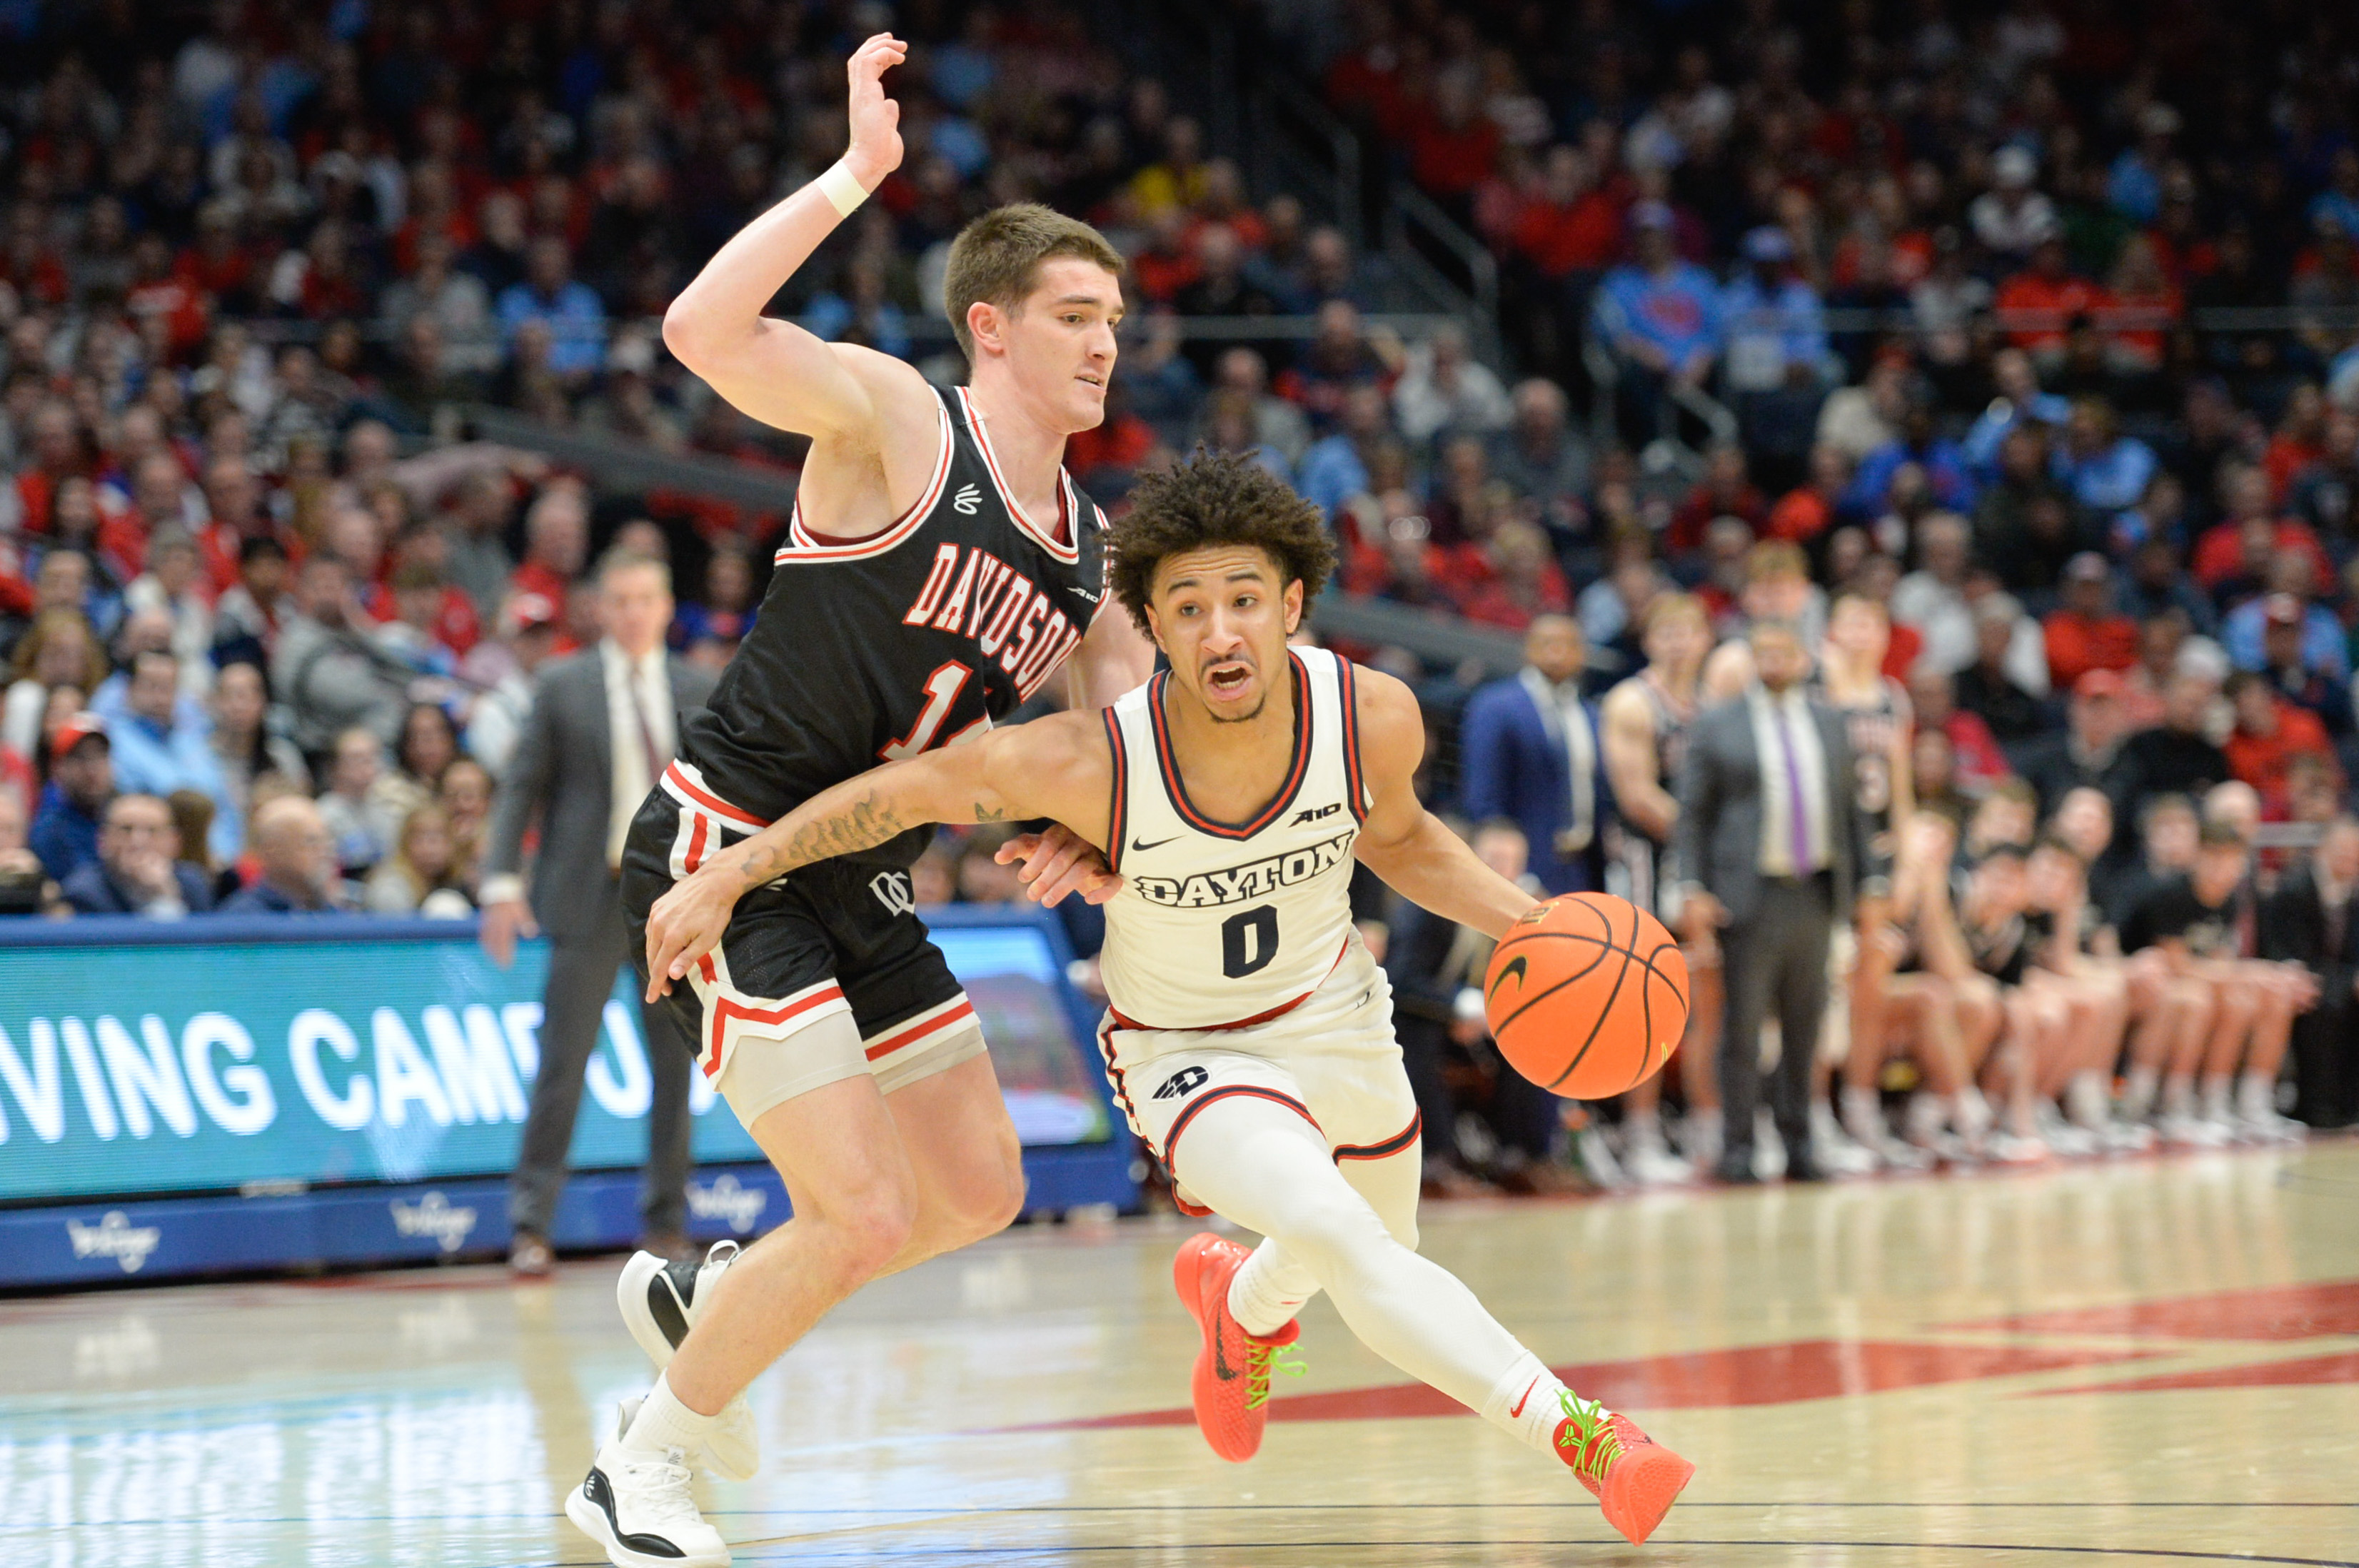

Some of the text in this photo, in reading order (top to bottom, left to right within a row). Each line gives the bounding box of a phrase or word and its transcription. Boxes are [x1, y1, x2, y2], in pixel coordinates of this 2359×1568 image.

[1287, 803, 1342, 828] A10
[1133, 828, 1355, 908] DAYTON
[1222, 904, 1279, 979] 0
[0, 1010, 279, 1144] VING
